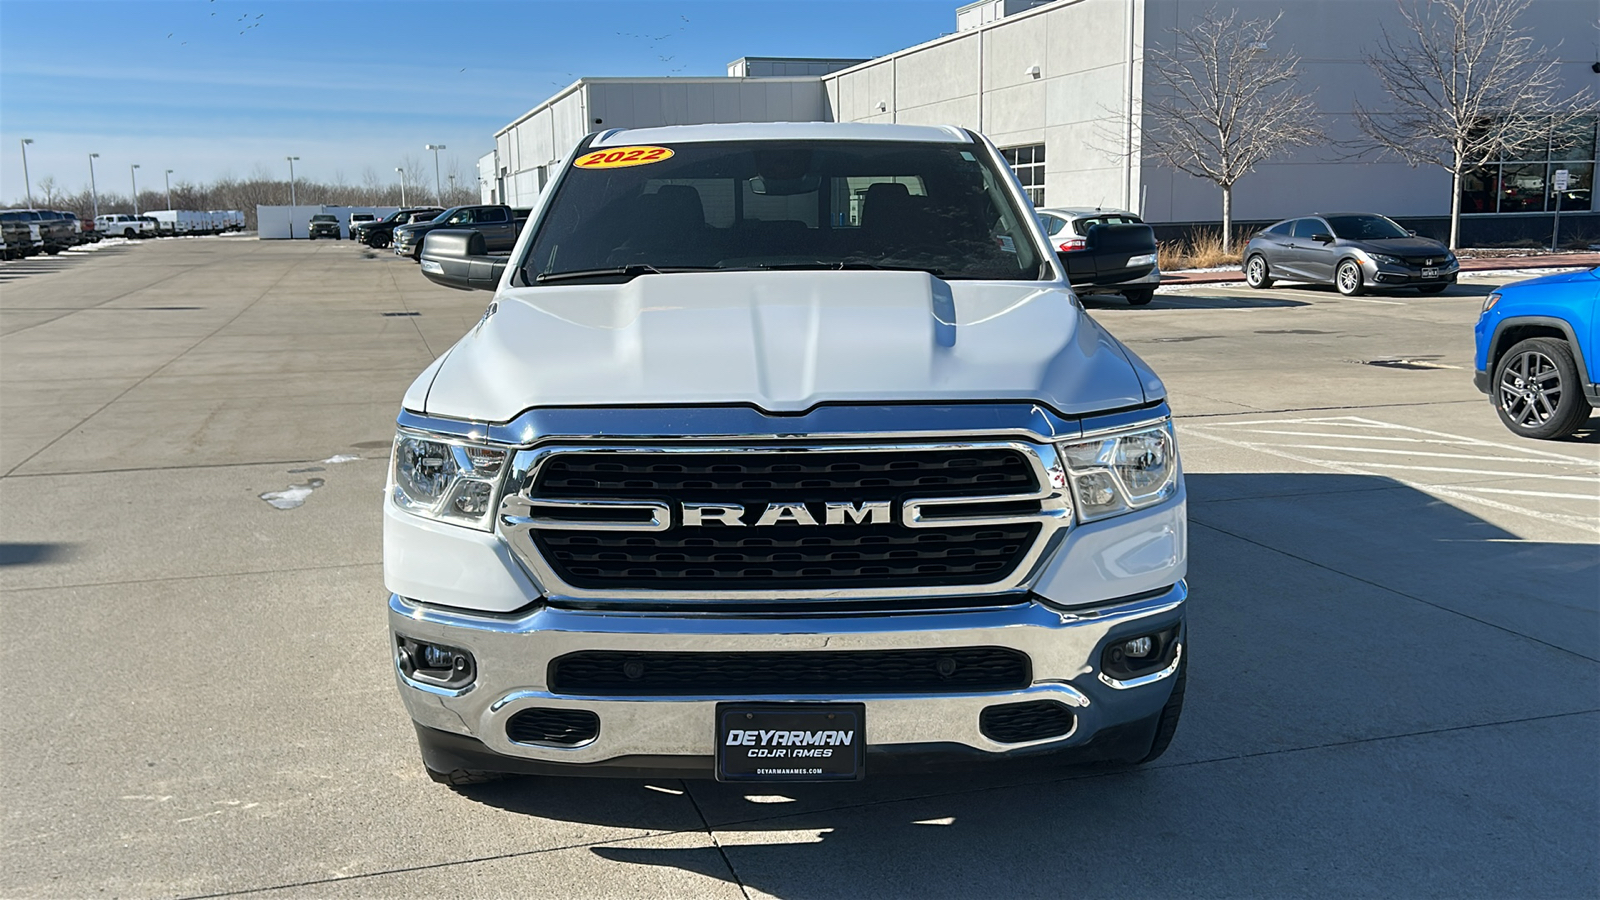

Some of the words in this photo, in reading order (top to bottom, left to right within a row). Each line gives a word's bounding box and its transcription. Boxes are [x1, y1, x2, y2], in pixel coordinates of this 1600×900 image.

[582, 149, 666, 166] 2022
[681, 501, 892, 527] RAM
[726, 730, 854, 746] DEYARMAN
[747, 749, 787, 758] CDJR
[792, 749, 833, 758] AMES
